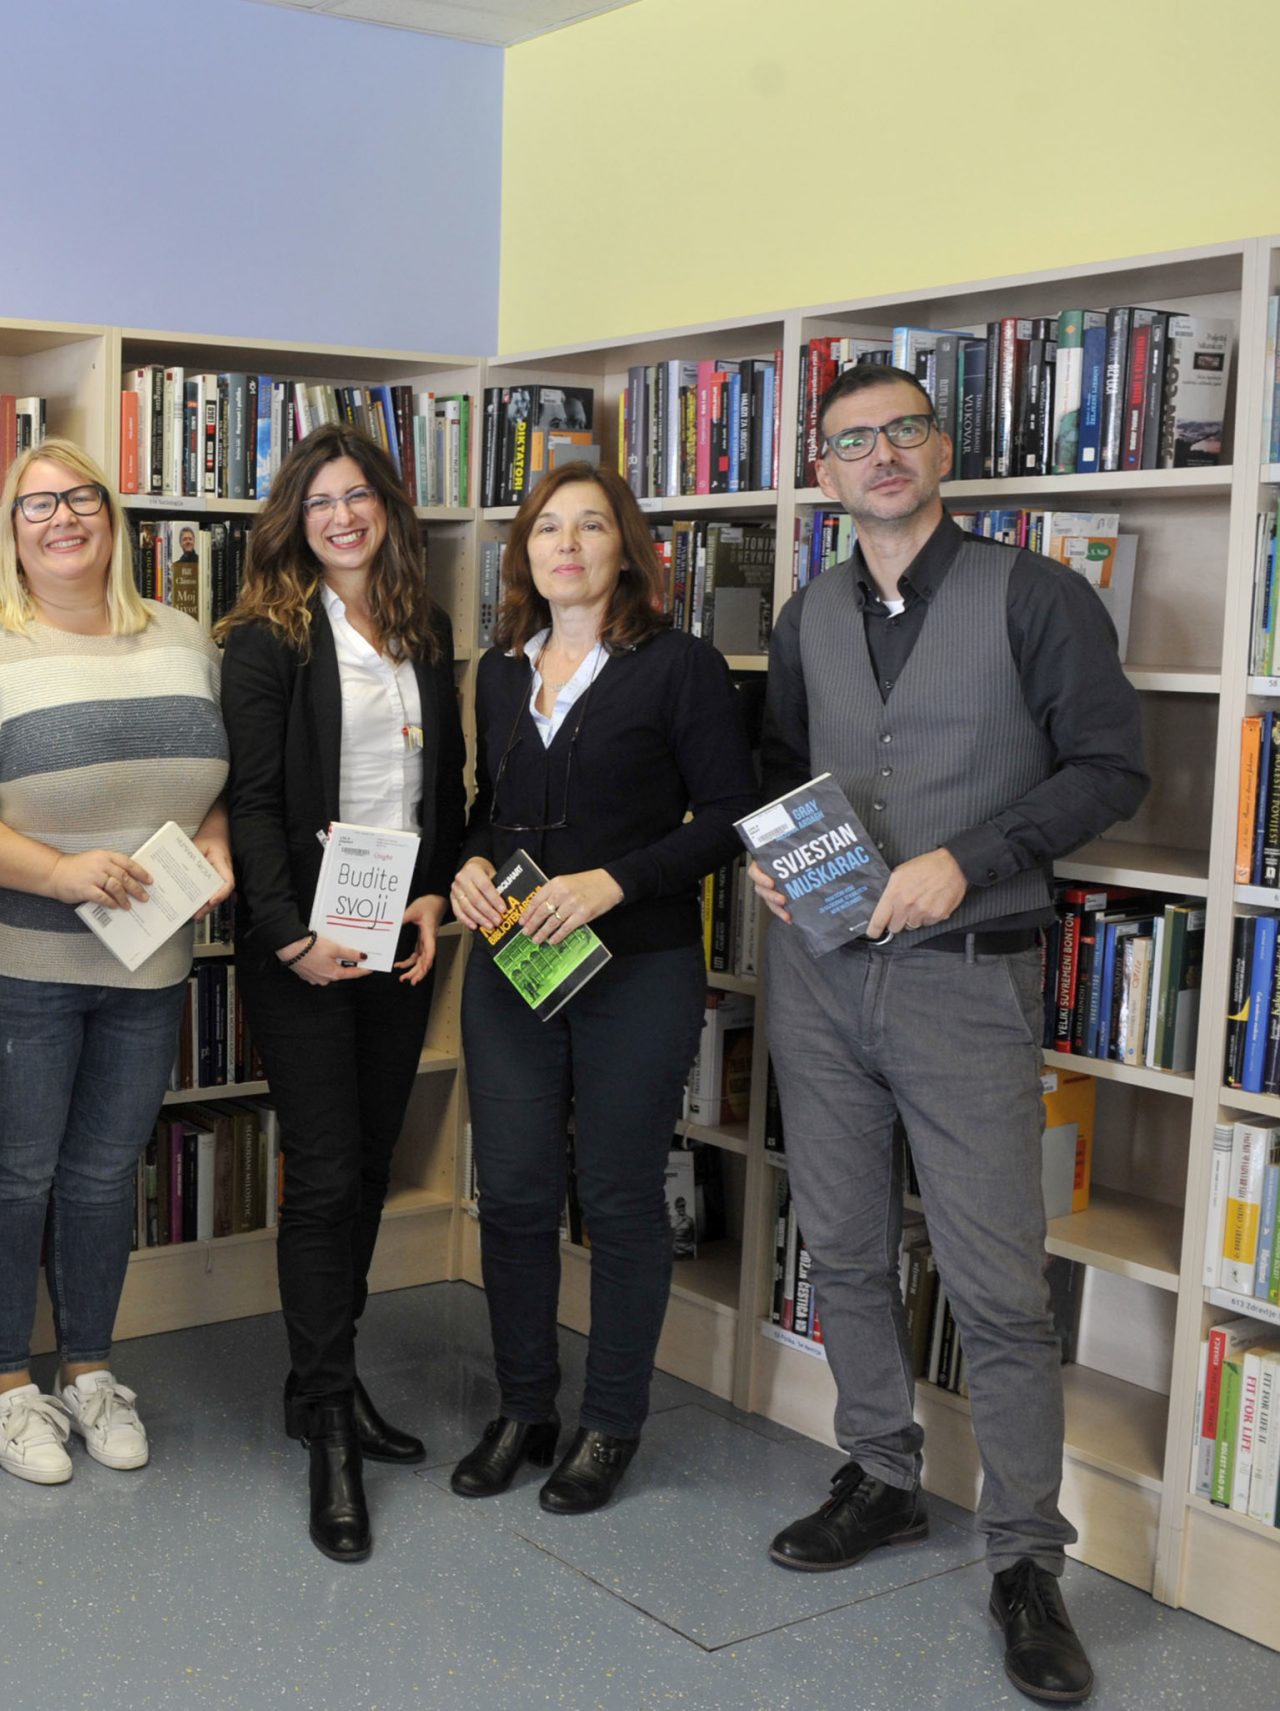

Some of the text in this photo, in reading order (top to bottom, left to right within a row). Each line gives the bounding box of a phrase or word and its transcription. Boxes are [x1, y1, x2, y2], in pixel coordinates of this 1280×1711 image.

[963, 394, 973, 455] VUKOVAR
[515, 422, 526, 490] DIKTATORI
[807, 427, 818, 462] Rijeka
[792, 799, 819, 820] GRAY
[771, 822, 858, 879] SVJESTAN
[337, 862, 399, 892] Budite
[784, 845, 870, 900] MUŠKARAC
[335, 893, 389, 930] svoji
[1058, 912, 1074, 1036] VELIKI SUVREMENI BONTON
[795, 1280, 810, 1318] ČESTICA
[1263, 1372, 1272, 1388] FIT
[1240, 1375, 1257, 1454] FIT FOR LIFE
[1261, 1390, 1271, 1409] FOR
[1258, 1412, 1269, 1432] LIFE
